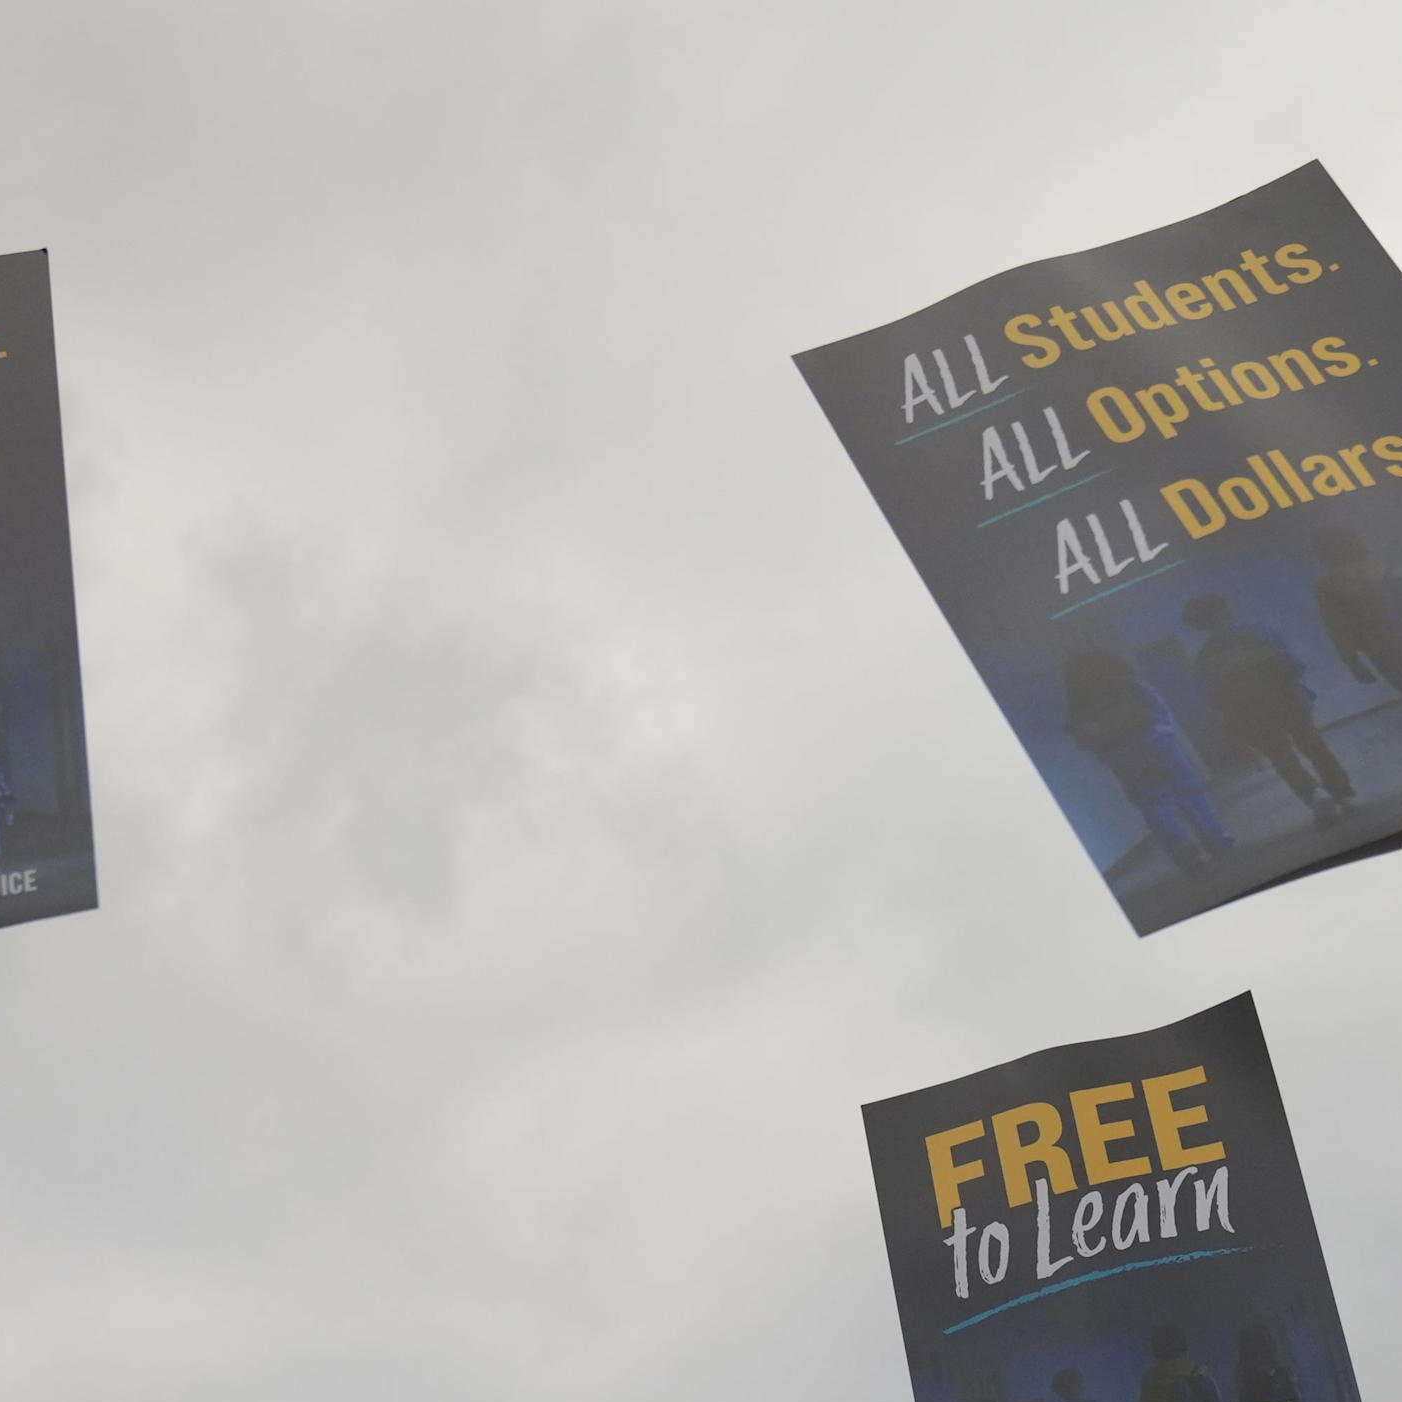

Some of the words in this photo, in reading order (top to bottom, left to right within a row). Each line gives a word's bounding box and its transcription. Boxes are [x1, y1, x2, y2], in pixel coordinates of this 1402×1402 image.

[900, 334, 1009, 424] ALL
[1003, 242, 1341, 370] Students.
[978, 407, 1091, 500] ALL
[1085, 334, 1379, 444] Options.
[1053, 499, 1170, 594] ALL
[925, 1065, 1226, 1228] FREE
[943, 1207, 1010, 1299] to
[1035, 1165, 1235, 1279] Learn
